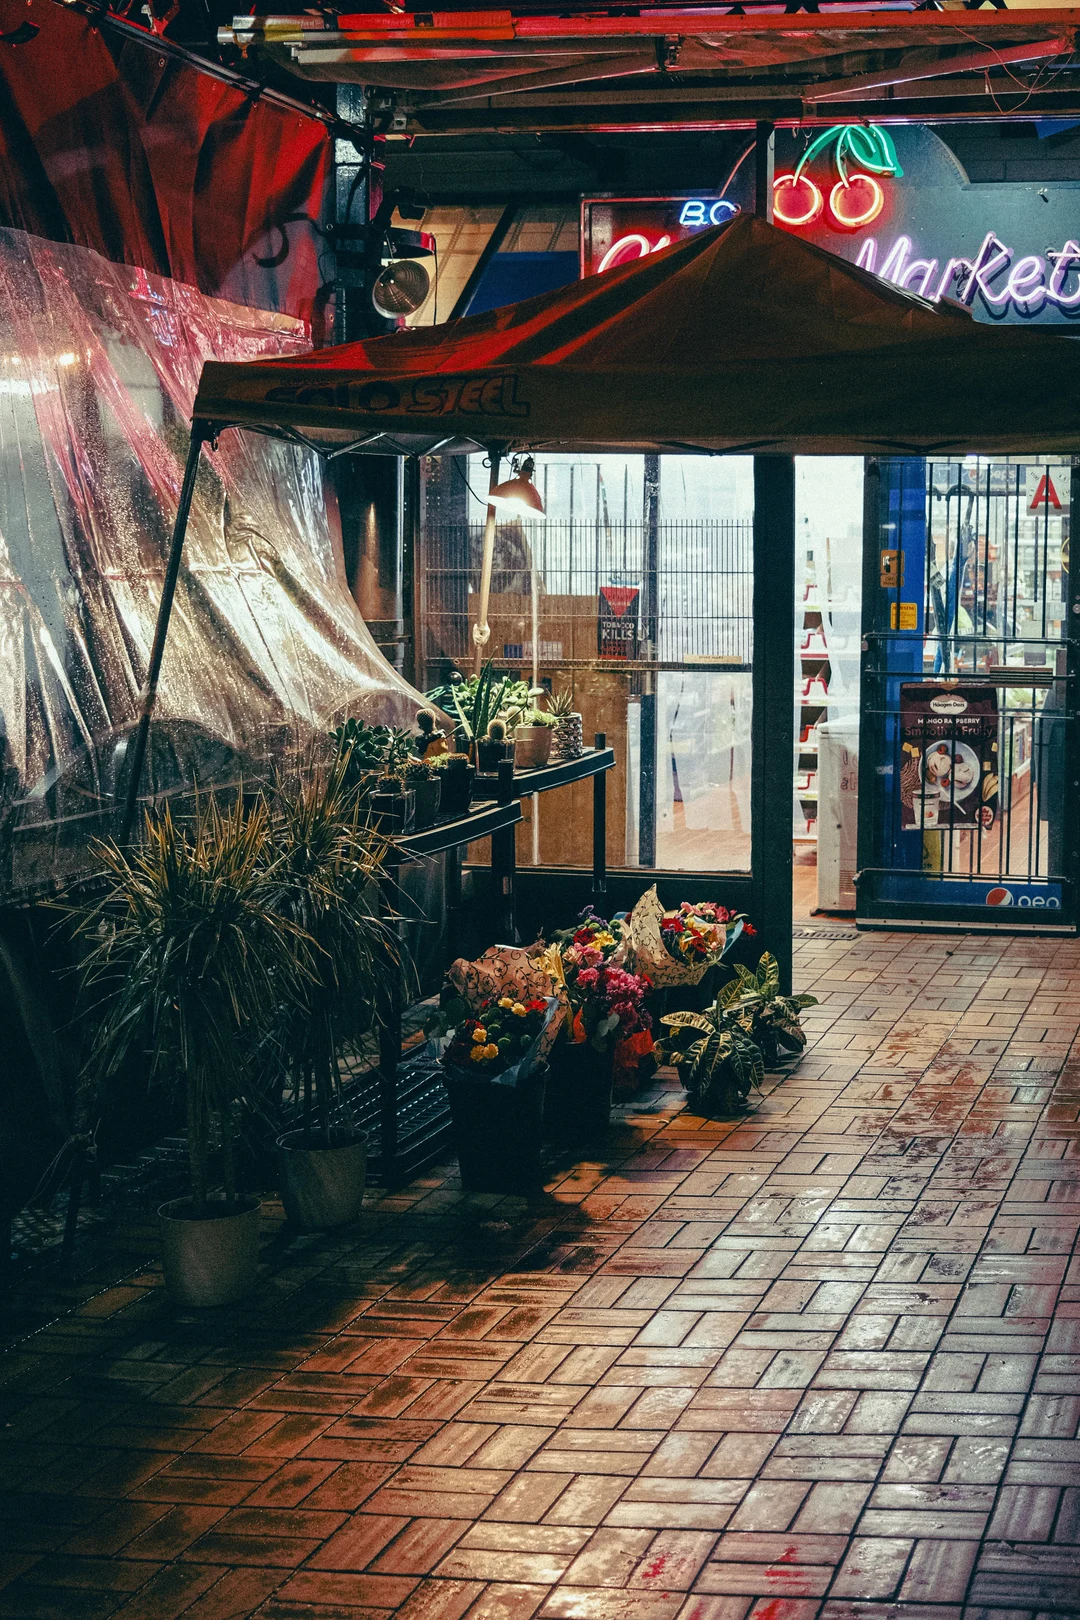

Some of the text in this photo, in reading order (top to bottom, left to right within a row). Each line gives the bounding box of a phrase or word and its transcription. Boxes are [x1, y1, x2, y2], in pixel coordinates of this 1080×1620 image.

[855, 231, 1080, 303] Market
[406, 373, 531, 418] STEEL
[1029, 474, 1063, 510] A
[602, 621, 635, 630] TOBACCO
[602, 629, 634, 640] KILLS
